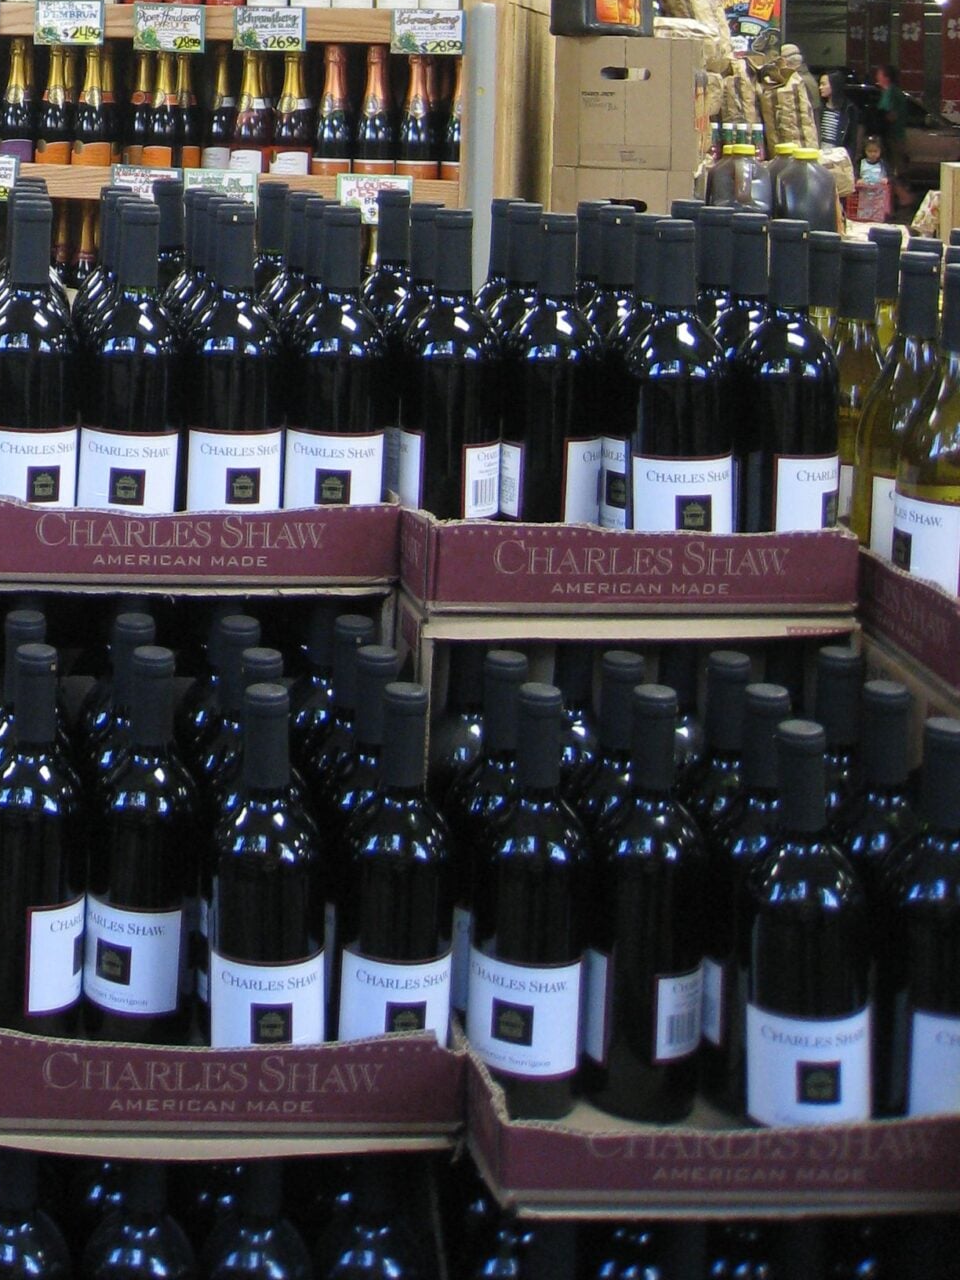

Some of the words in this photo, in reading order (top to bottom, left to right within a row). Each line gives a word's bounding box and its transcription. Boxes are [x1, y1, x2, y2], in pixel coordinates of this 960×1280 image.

[0, 441, 56, 456] CHARLES
[88, 441, 140, 458] CHARLES
[200, 442, 255, 457] CHARLES
[293, 441, 345, 459] CHARLES
[646, 469, 705, 484] CHARLES
[35, 513, 212, 549] CHARLES
[220, 515, 328, 550] SHAW
[93, 554, 206, 568] AMERICAN
[210, 554, 269, 568] MADE
[493, 539, 673, 577] CHARLES
[682, 540, 791, 577] SHAW
[551, 581, 666, 595] AMERICAN
[671, 582, 730, 596] MADE
[220, 969, 285, 991] CHARLES
[355, 969, 420, 991] CHARLES
[42, 1050, 249, 1094] CHARLES
[258, 1054, 384, 1094] SHAW
[108, 1098, 237, 1113] AMERICAN
[246, 1098, 315, 1114] MADE
